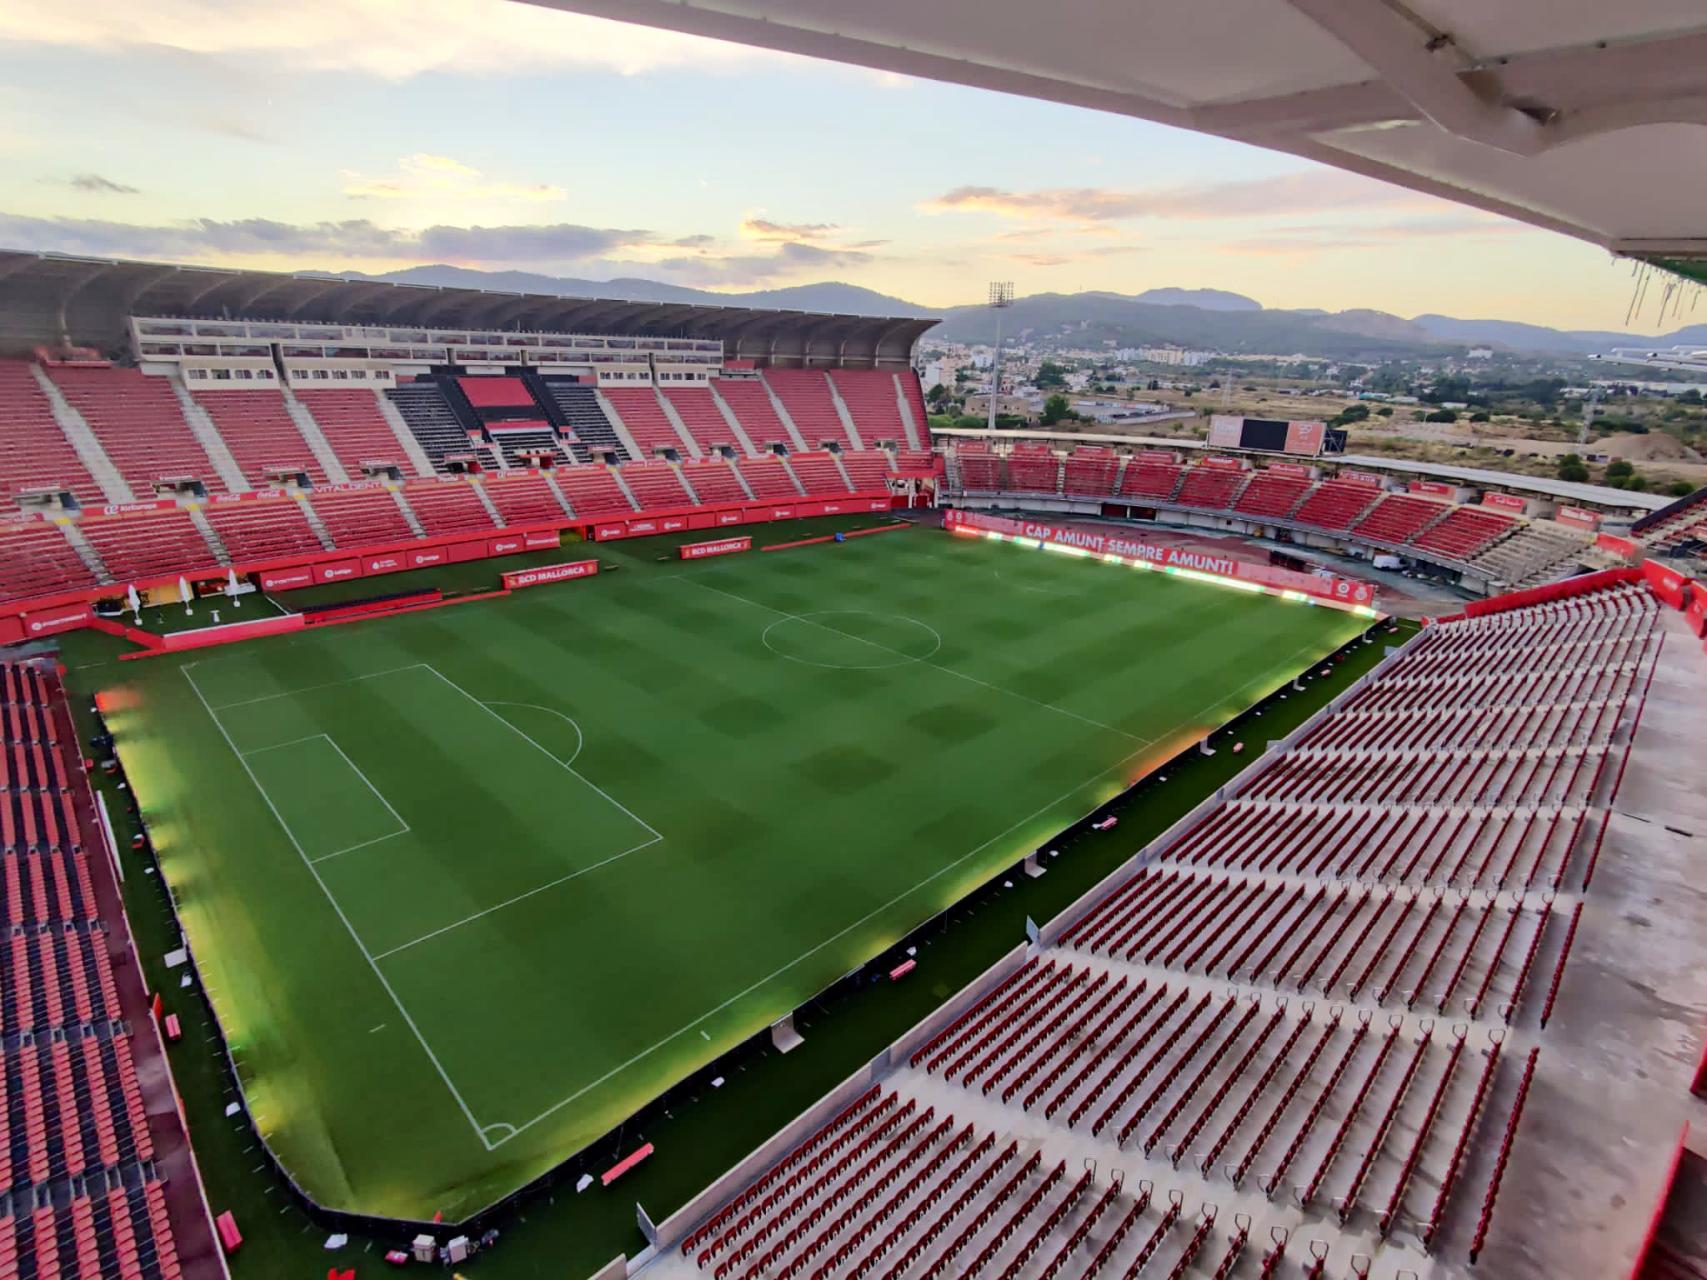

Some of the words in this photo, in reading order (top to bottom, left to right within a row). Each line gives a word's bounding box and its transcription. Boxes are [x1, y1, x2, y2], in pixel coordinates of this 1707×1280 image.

[1025, 525, 1051, 540] CAP
[1054, 530, 1104, 549] AMUNT
[1108, 539, 1164, 560] SEMPRE
[1167, 551, 1233, 575] AMUNT!
[518, 574, 537, 584] RCD
[538, 566, 585, 581] MALLORCA
